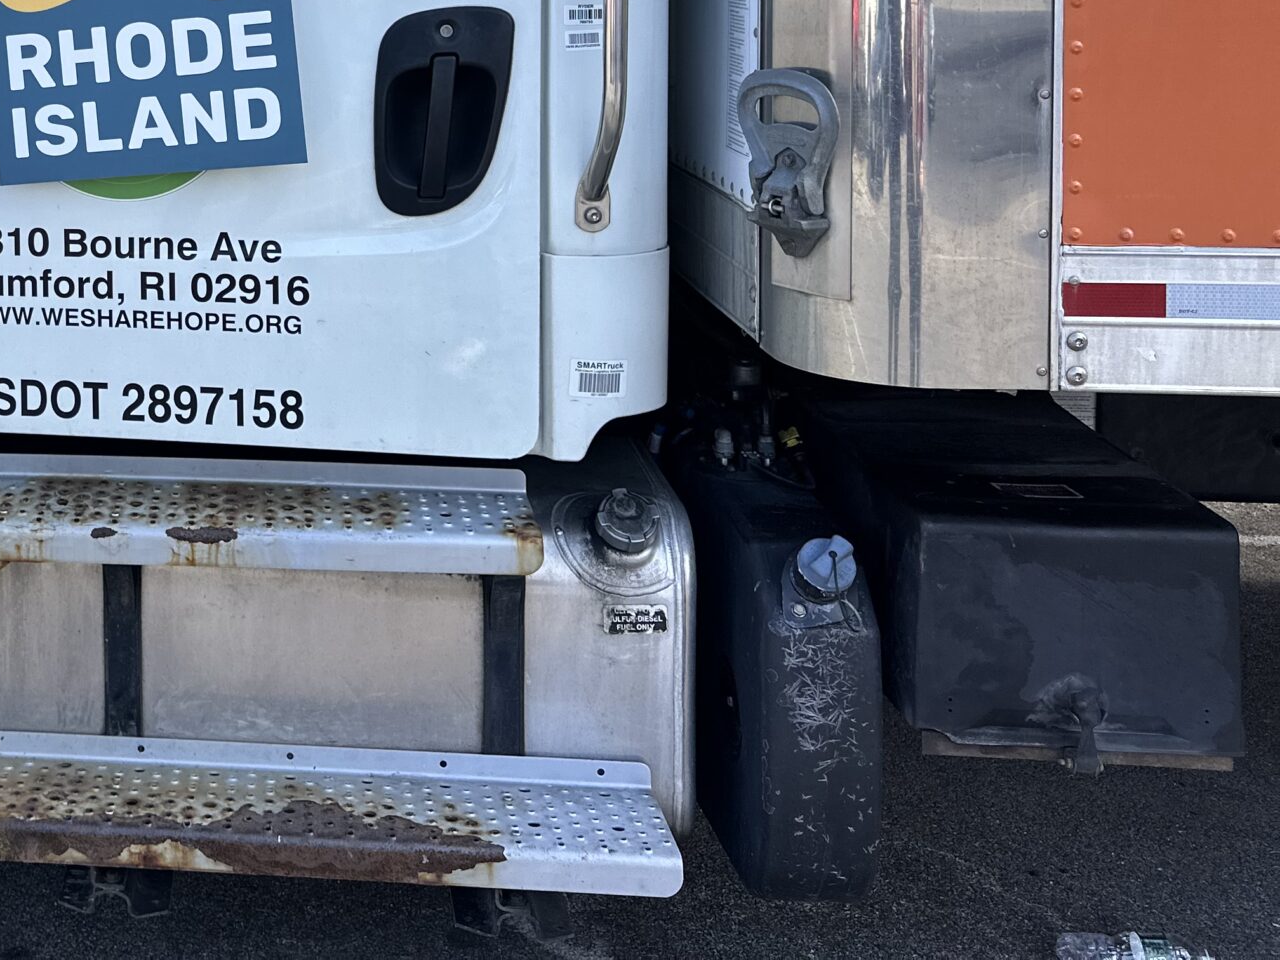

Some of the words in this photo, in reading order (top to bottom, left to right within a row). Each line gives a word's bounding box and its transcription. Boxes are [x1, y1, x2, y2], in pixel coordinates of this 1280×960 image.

[5, 10, 277, 91] RHODE
[11, 87, 282, 159] ISLAND
[63, 228, 198, 261] Bourne
[210, 231, 282, 263] Ave
[140, 271, 176, 301] RI
[190, 273, 310, 306] 02916
[576, 361, 624, 369] SMARTruck
[122, 382, 304, 430] 2897158
